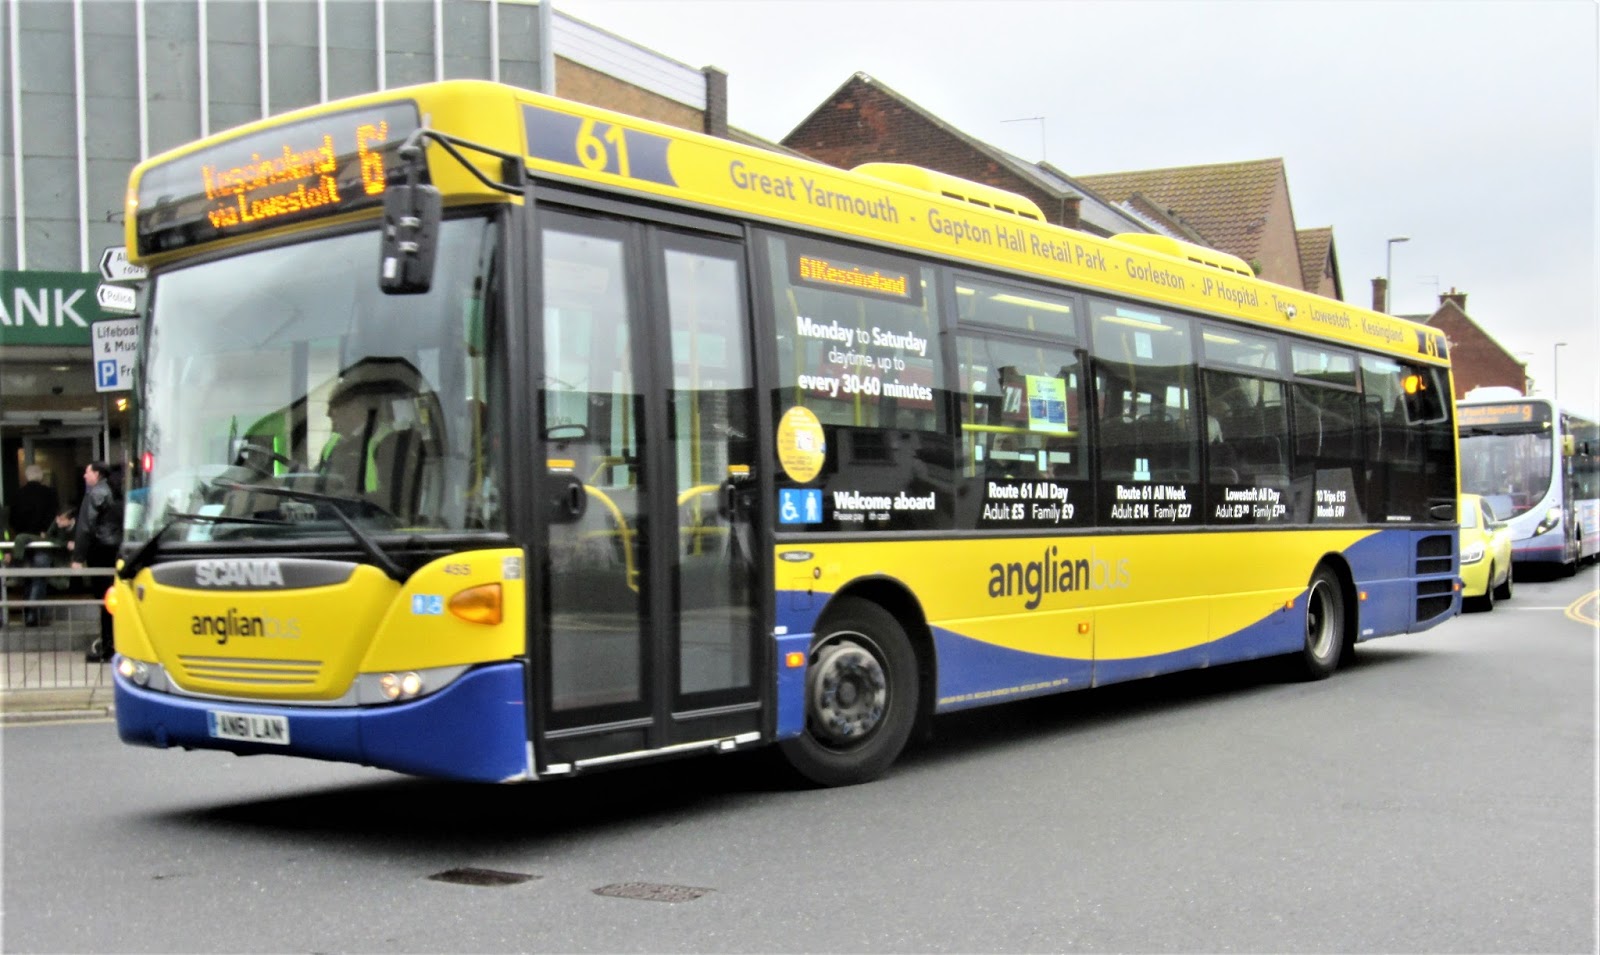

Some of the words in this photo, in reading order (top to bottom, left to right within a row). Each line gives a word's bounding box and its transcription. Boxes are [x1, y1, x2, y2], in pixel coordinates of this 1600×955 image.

[576, 118, 630, 176] 61
[729, 160, 796, 201] Great
[800, 177, 899, 223] Yarmouth
[928, 208, 992, 244] Gapton
[995, 225, 1027, 253] Hall
[1030, 233, 1072, 264] Retail
[1075, 244, 1107, 271] Park
[1125, 258, 1185, 290] Gorleston
[1202, 277, 1213, 296] JP
[1217, 282, 1259, 308] Hospital
[1310, 304, 1351, 328] Lowestoft
[1361, 318, 1404, 343] Kessingland
[796, 316, 854, 347] Monday
[856, 328, 870, 344] to
[872, 327, 927, 357] Saturday
[104, 341, 111, 353] &
[828, 346, 876, 369] daytime,
[877, 358, 892, 373] up
[893, 356, 906, 371] to
[798, 374, 839, 397] every
[842, 373, 881, 396] 30-60
[883, 379, 933, 401] minutes
[833, 490, 892, 510] Welcome
[893, 491, 936, 510] aboard
[988, 481, 1019, 498] Route
[1020, 483, 1032, 498] 61
[1035, 482, 1048, 498] All
[1050, 483, 1068, 503] Day
[1117, 485, 1141, 500] Route
[1142, 485, 1152, 500] 61
[1153, 485, 1164, 500] All
[1165, 485, 1186, 500] Week
[1225, 487, 1258, 501] Lowestoft
[1258, 487, 1267, 501] All
[1268, 488, 1280, 504] Day
[1316, 489, 1323, 502] 10
[1323, 489, 1336, 505] Trips
[1336, 490, 1346, 503] £15
[983, 503, 1010, 520] Adult
[1011, 503, 1025, 519] £5
[1032, 503, 1060, 524] Family
[1062, 503, 1074, 519] £9
[1111, 504, 1133, 519] Adult
[1134, 504, 1149, 519] £14
[1154, 504, 1177, 522] Family
[1178, 503, 1192, 518] £27
[1215, 504, 1233, 518] Adult
[1253, 504, 1271, 521] Family
[1317, 505, 1334, 517] Month
[195, 560, 284, 586] SCANIA
[444, 564, 471, 575] 455
[220, 714, 251, 737] AN61
[251, 717, 283, 740] LAN
